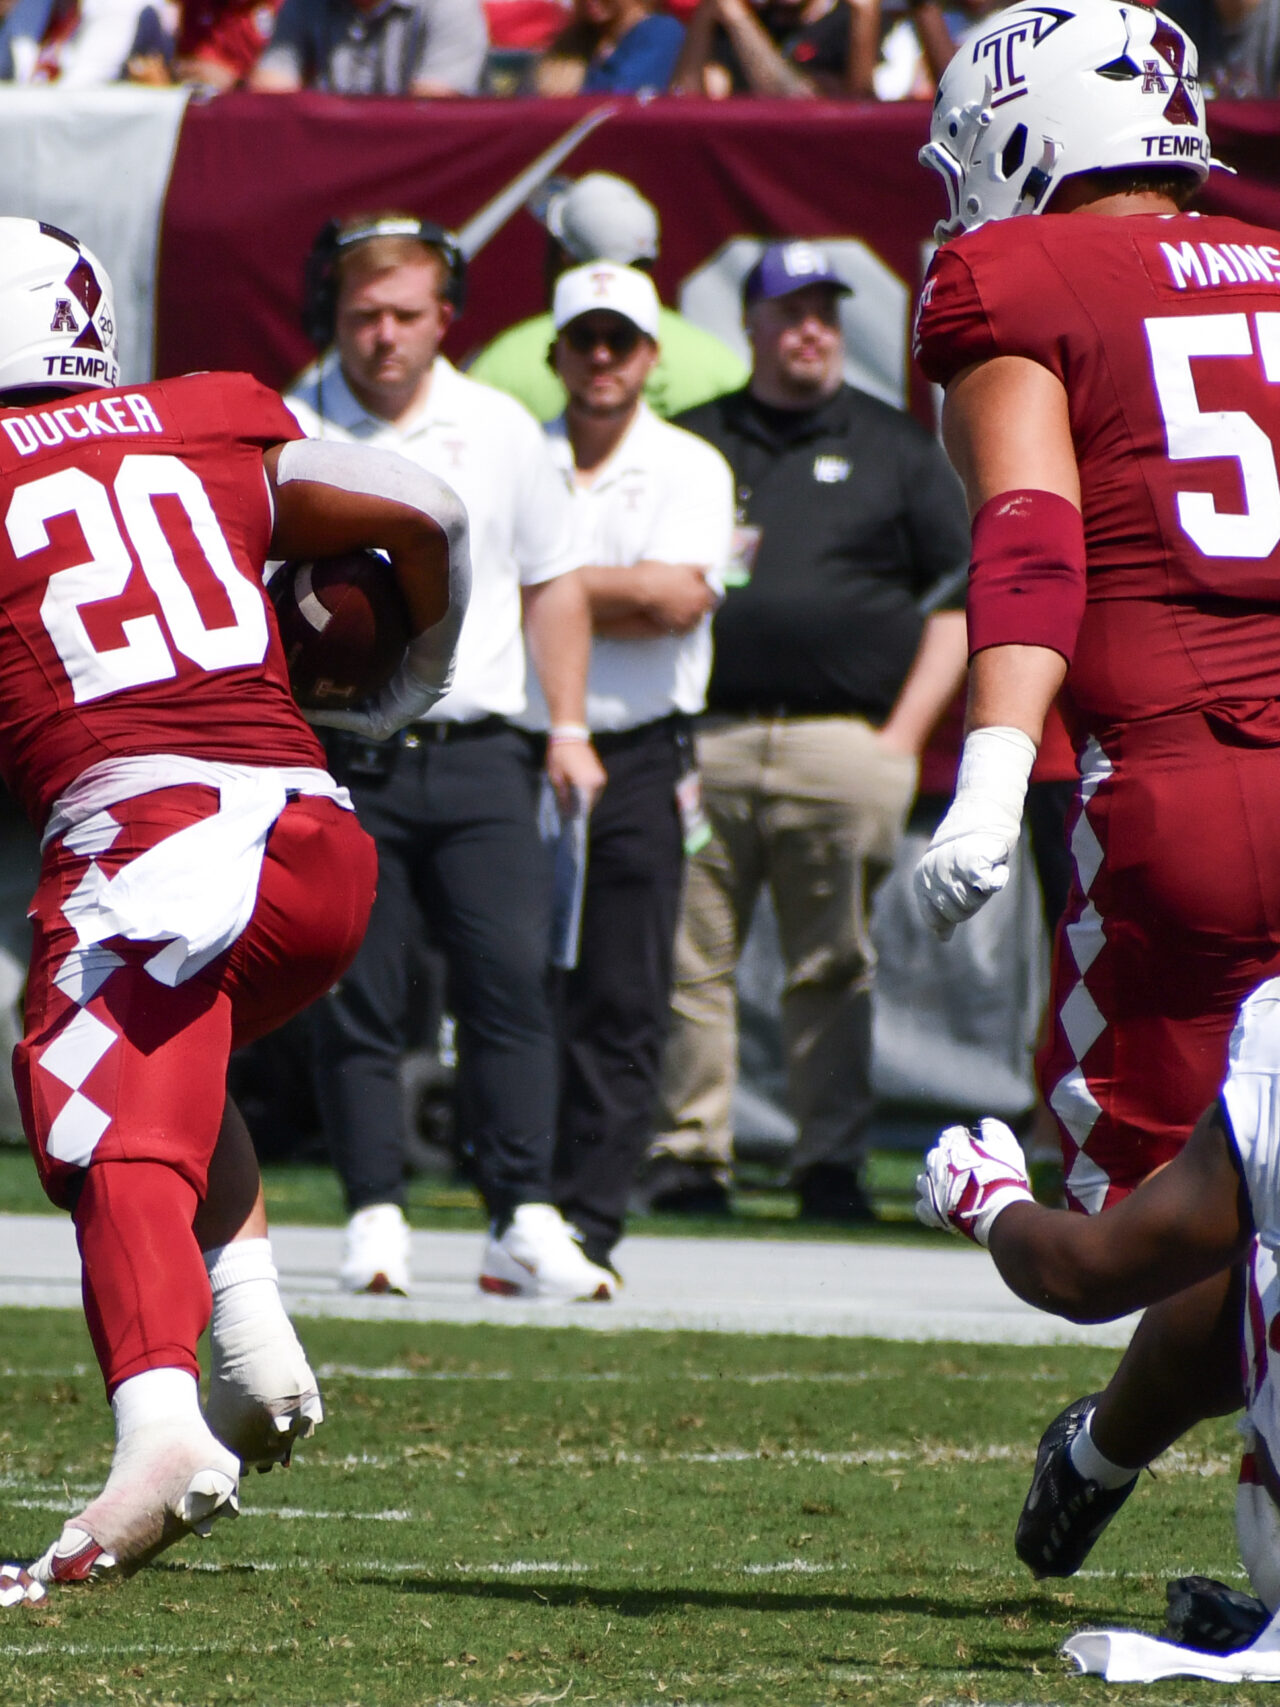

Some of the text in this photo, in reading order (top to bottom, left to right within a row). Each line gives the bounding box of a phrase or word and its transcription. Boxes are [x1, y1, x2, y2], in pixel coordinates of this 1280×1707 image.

[1141, 60, 1169, 93] A
[590, 272, 615, 297] T
[51, 298, 79, 332] A
[100, 316, 113, 335] 20
[43, 356, 117, 388] TEMPLE
[1, 394, 163, 456] DUCKER
[1144, 311, 1280, 558] 5
[5, 455, 269, 704] 20
